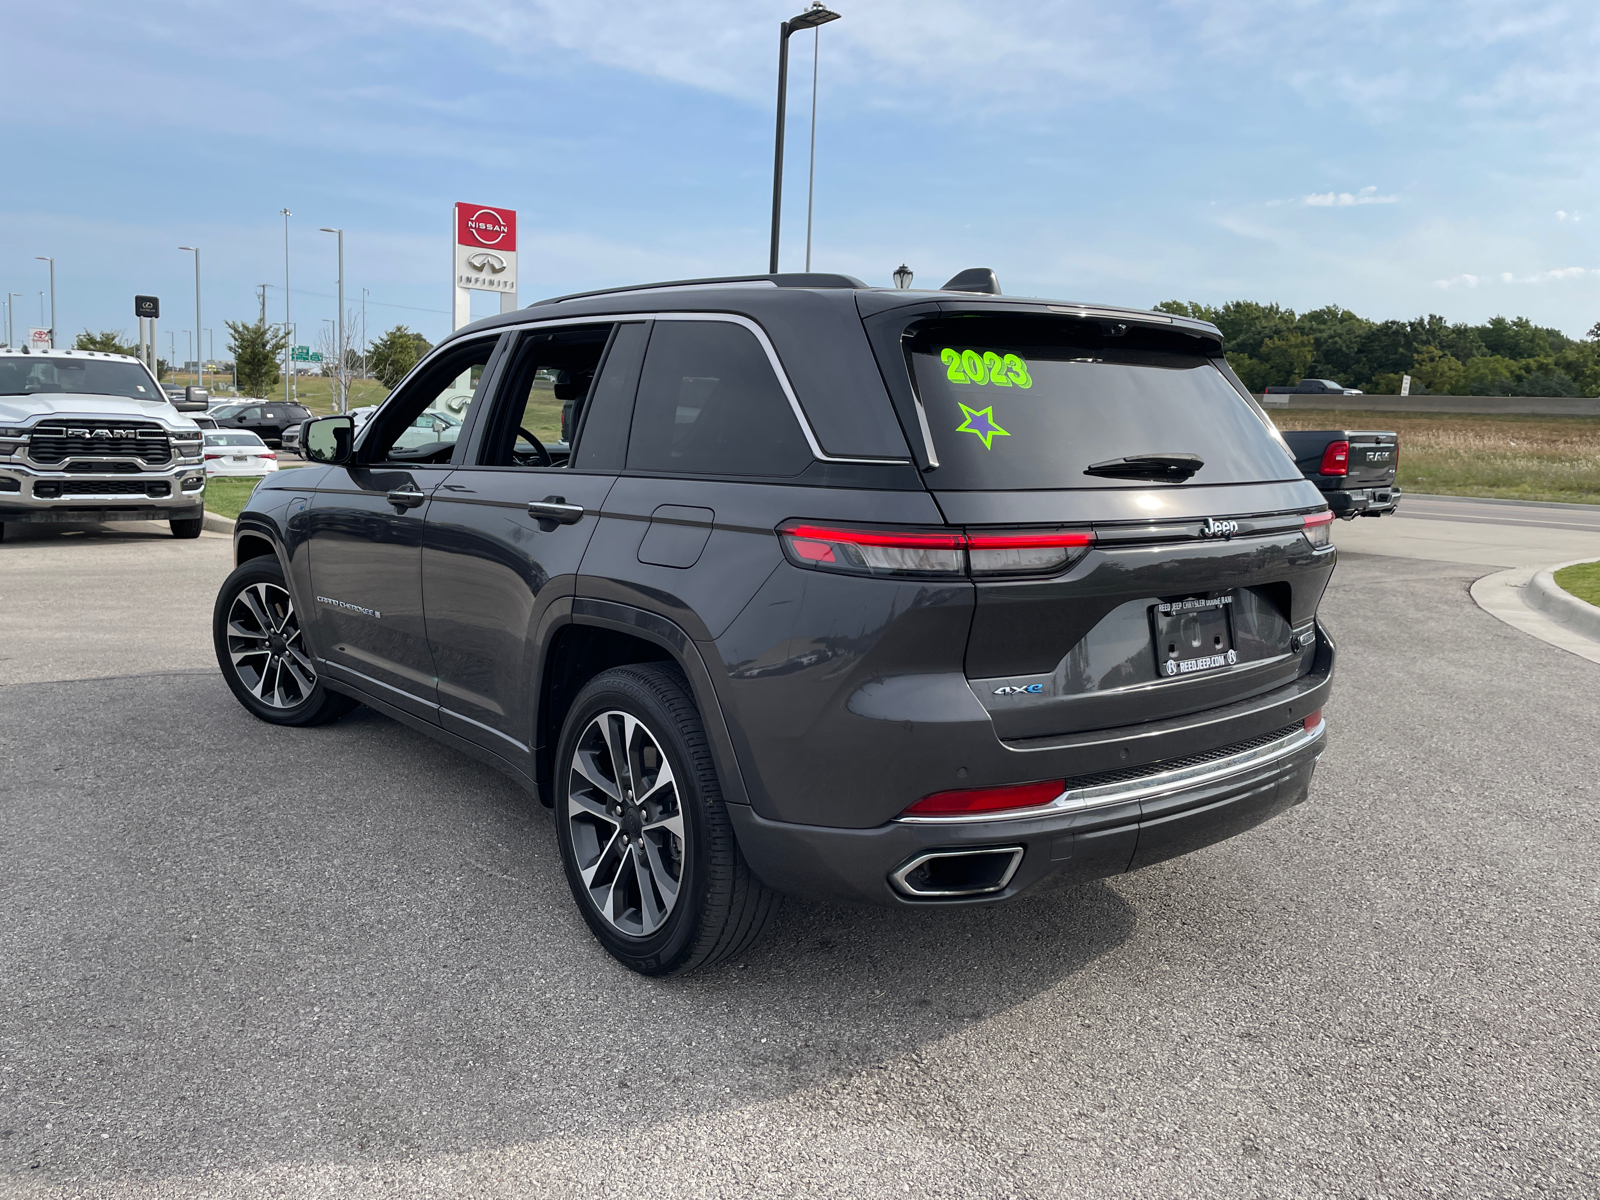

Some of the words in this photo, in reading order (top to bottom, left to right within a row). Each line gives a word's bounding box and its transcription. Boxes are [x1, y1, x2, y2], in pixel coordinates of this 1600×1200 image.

[468, 221, 508, 233] NISSAN
[459, 275, 515, 289] INFINITI
[940, 348, 1033, 389] 2023
[67, 428, 135, 439] RAM
[1366, 452, 1390, 462] RAM
[1203, 517, 1239, 537] Jeep
[316, 595, 339, 606] GRAND
[339, 601, 375, 617] CHEROKEE
[1158, 603, 1171, 612] REED
[1172, 602, 1182, 611] JEEP
[1221, 595, 1233, 604] RAM
[1179, 655, 1225, 673] REEDJEEP.COM
